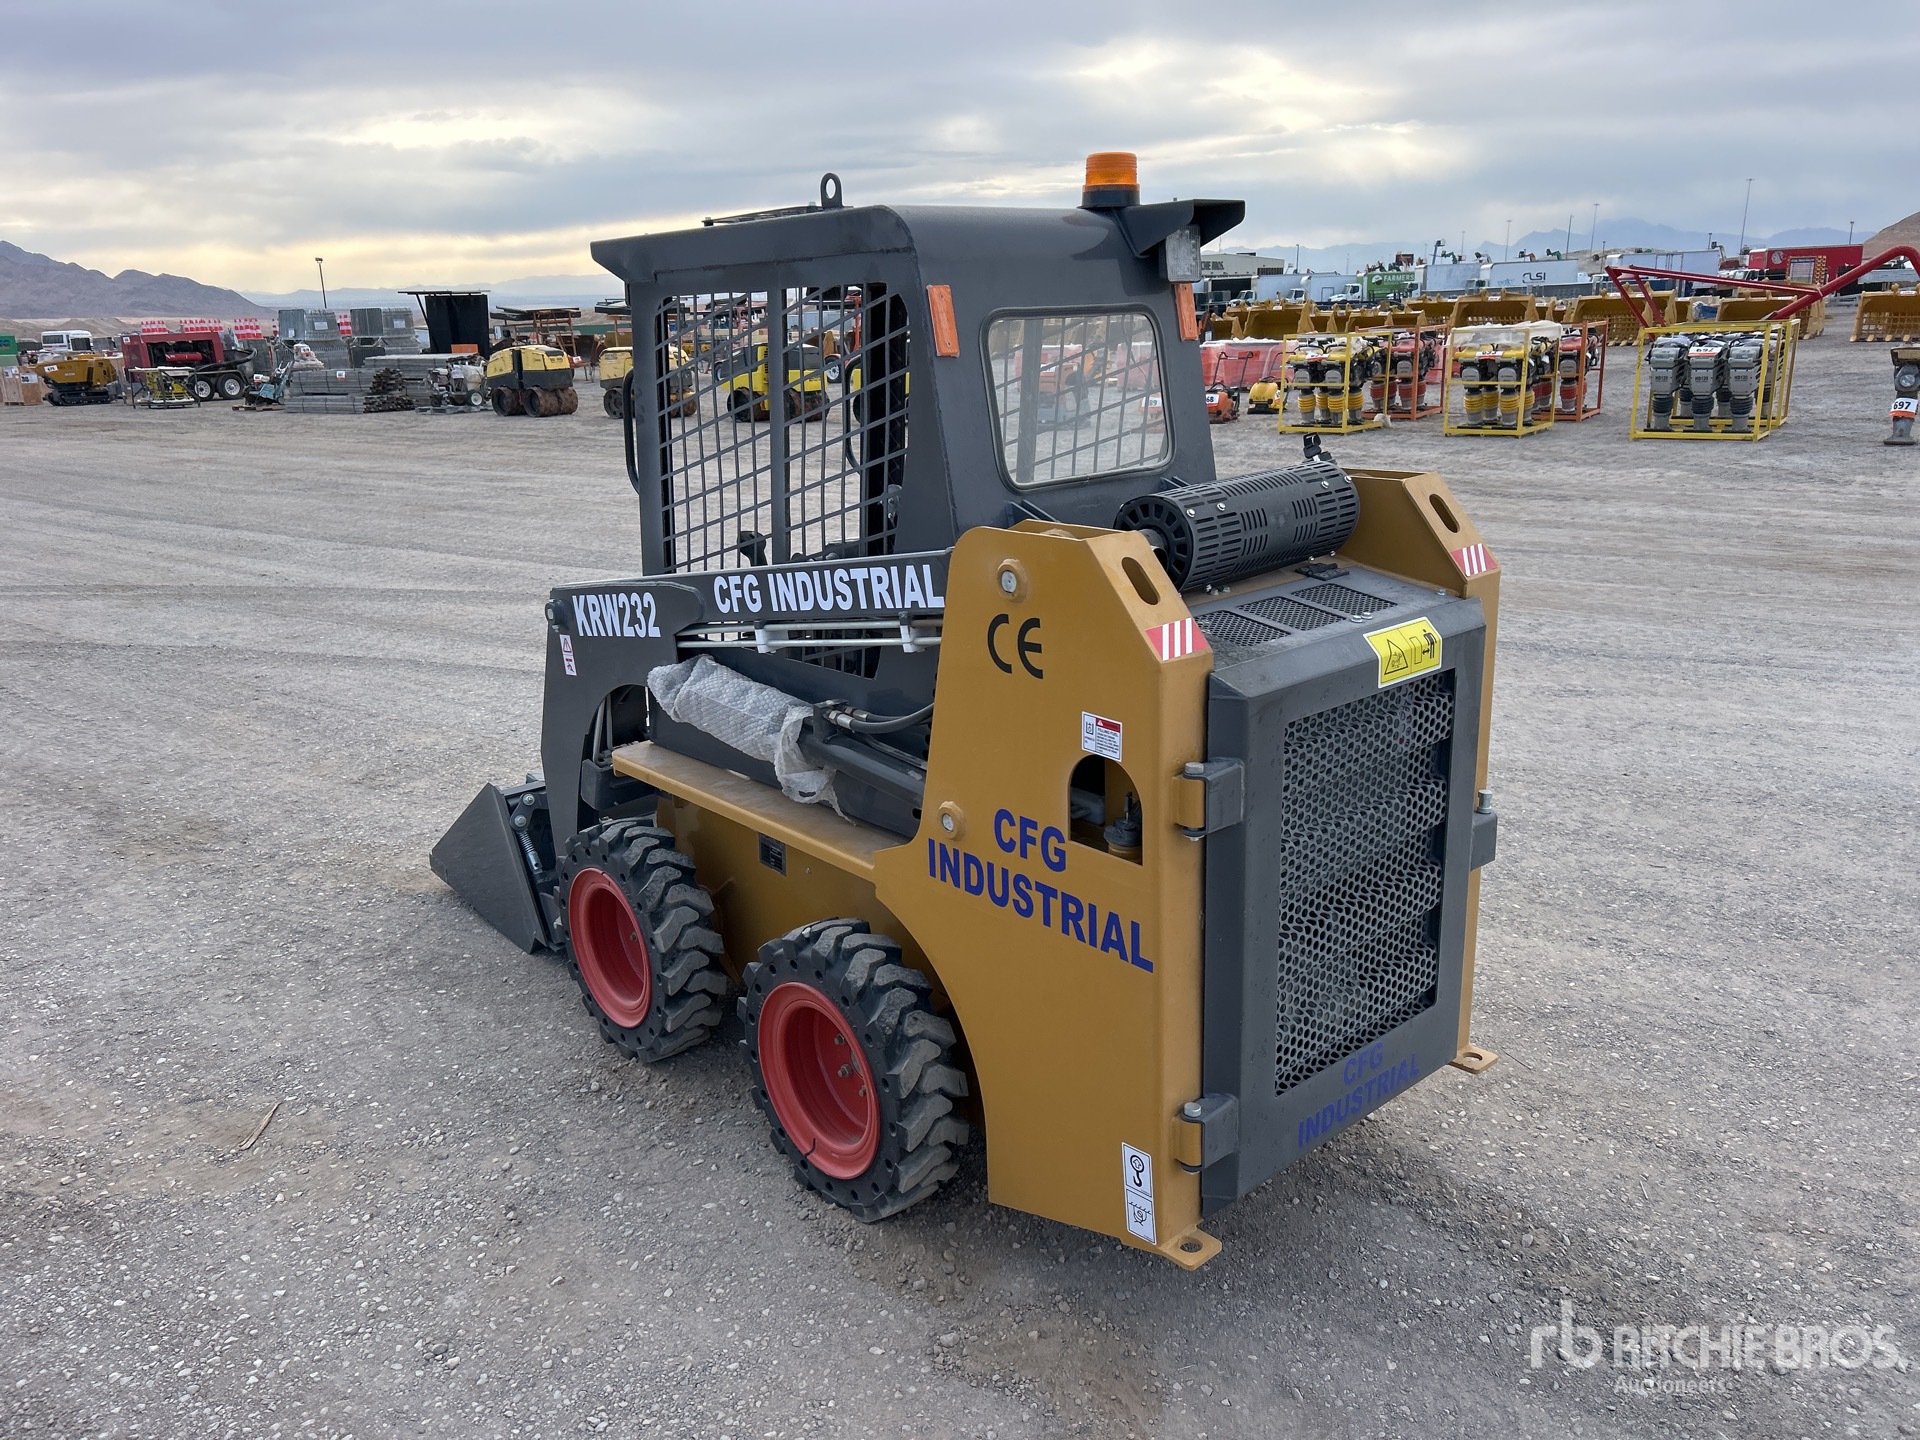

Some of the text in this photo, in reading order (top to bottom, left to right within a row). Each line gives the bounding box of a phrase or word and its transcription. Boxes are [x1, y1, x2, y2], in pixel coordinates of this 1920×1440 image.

[1893, 401, 1911, 410] 697
[571, 592, 662, 639] KRW232
[713, 564, 945, 614] CFG INDUSTRIAL
[987, 613, 1044, 680] CE
[994, 808, 1067, 873] CFG
[928, 838, 1154, 974] INDUSTRIAL
[1343, 1041, 1384, 1086] CFG
[1298, 1053, 1421, 1149] INDUSTRIAL
